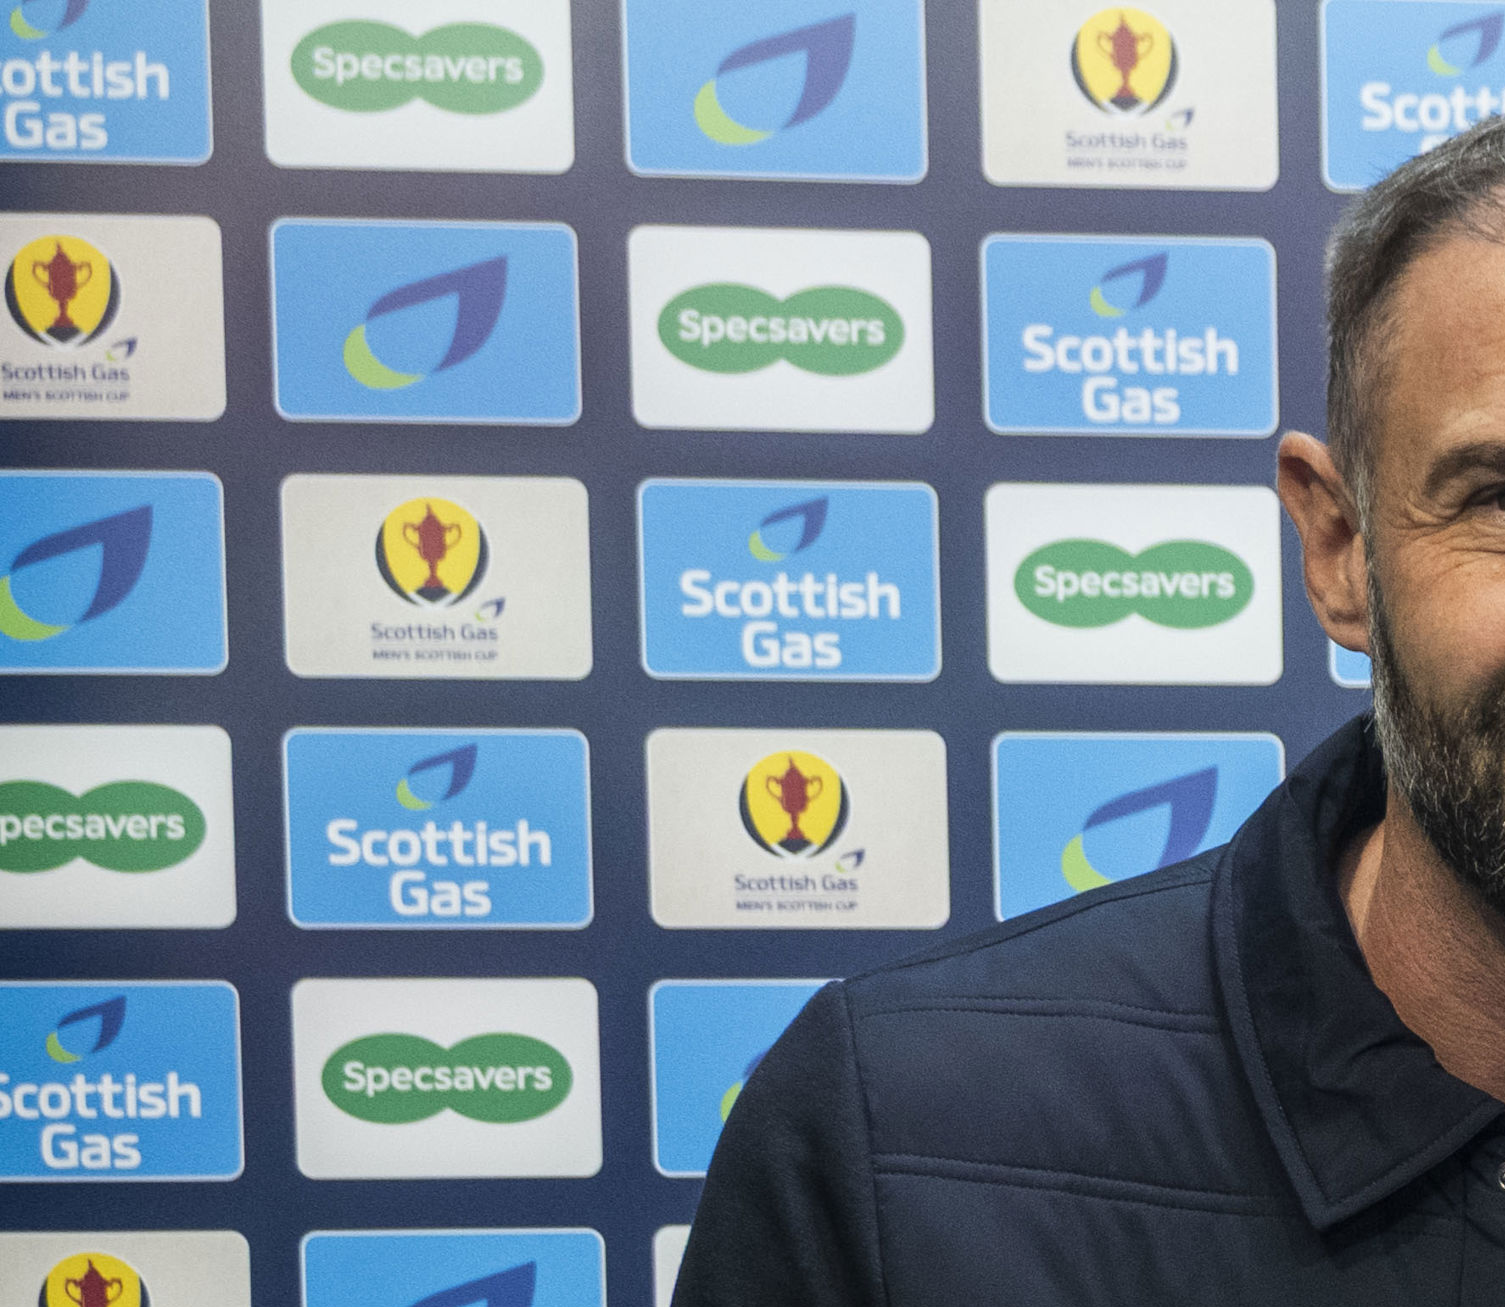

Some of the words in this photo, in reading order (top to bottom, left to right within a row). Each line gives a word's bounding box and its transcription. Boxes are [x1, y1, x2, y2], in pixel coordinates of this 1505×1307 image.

[0, 51, 170, 99] ottish
[313, 46, 524, 85] Specsavers
[4, 100, 108, 150] Gas
[678, 308, 885, 347] Specsavers
[1022, 324, 1238, 375] Scottish
[0, 364, 86, 382] Scottish
[90, 364, 129, 382] Gas
[1082, 378, 1180, 423] Gas
[680, 569, 900, 619] Scottish
[1034, 565, 1235, 602] Specsavers
[371, 624, 455, 642] Scottish
[460, 624, 498, 642] Gas
[742, 620, 842, 668] Gas
[0, 813, 185, 845] pecsavers
[326, 819, 551, 866] Scottish
[390, 870, 491, 916] Gas
[734, 874, 816, 892] Scottish
[821, 874, 858, 892] Gas
[343, 1061, 552, 1097] Specsavers
[41, 1123, 141, 1169] Gas
